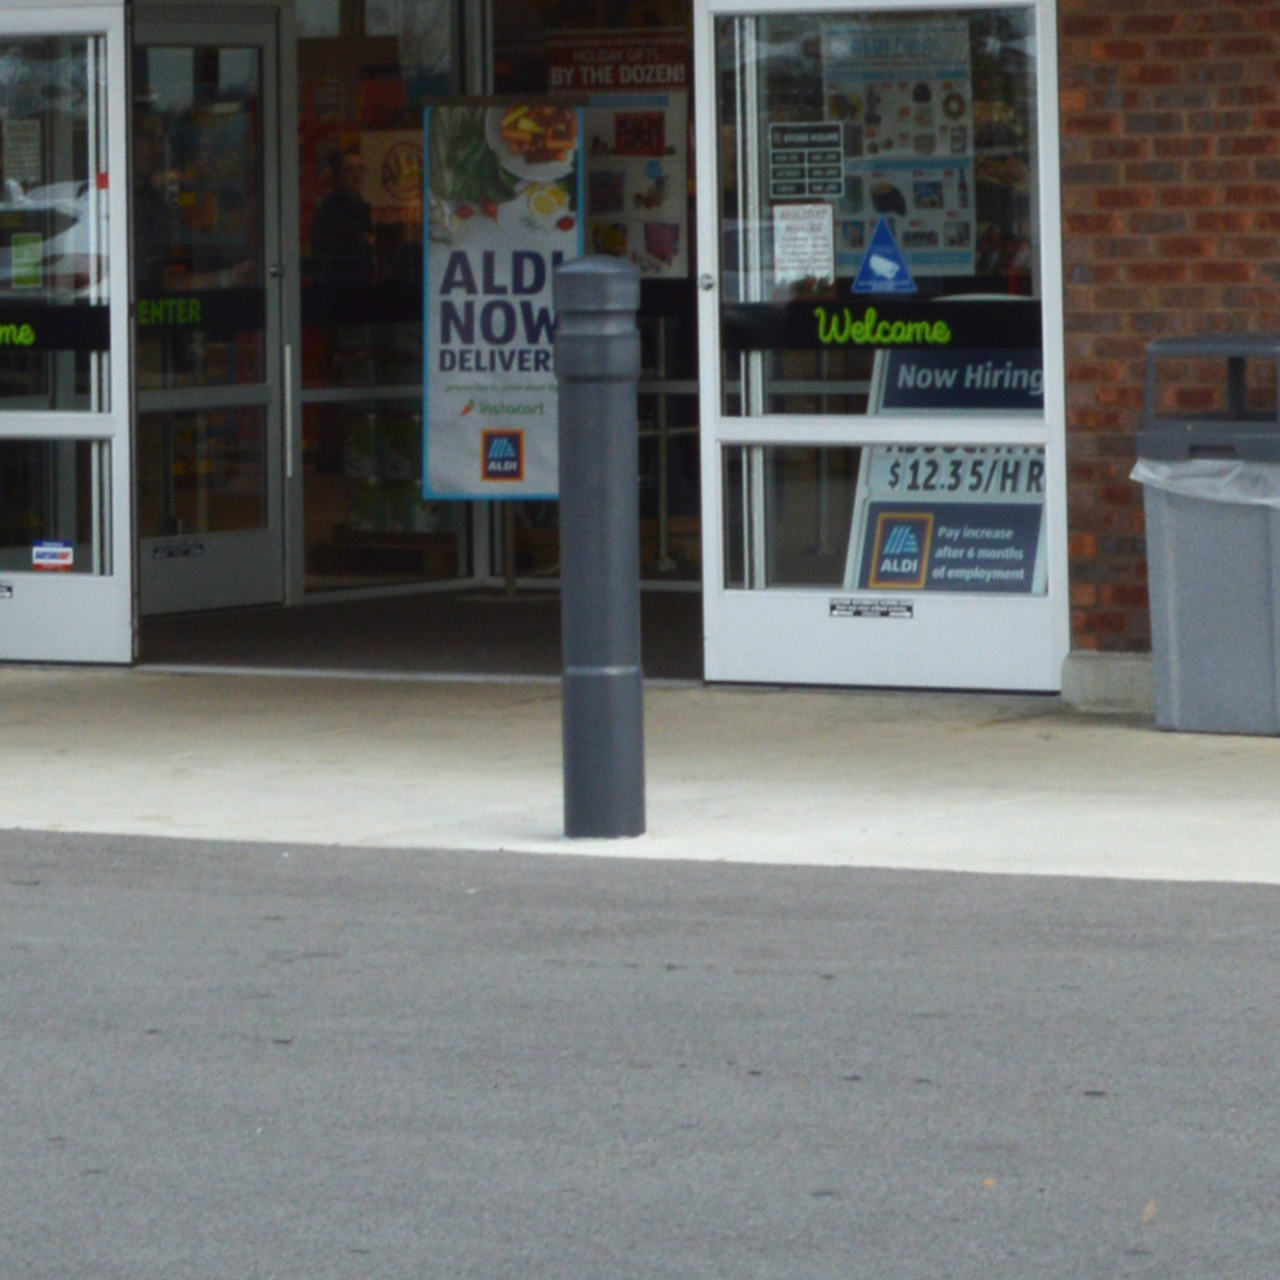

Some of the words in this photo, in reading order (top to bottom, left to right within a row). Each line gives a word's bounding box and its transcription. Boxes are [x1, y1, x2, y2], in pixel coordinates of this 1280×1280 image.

[550, 65, 575, 85] BY
[579, 64, 615, 84] THE
[618, 63, 686, 84] DOZEN!
[138, 298, 202, 325] ENTER
[440, 299, 558, 346] NOW
[814, 306, 952, 345] Welcome
[439, 349, 552, 372] DELIVER
[897, 363, 958, 389] Now
[964, 360, 1044, 396] Hiring
[487, 460, 518, 471] ALDI
[937, 525, 960, 541] Pay
[963, 525, 1014, 539] increase
[934, 547, 964, 560] after
[966, 547, 975, 559] 6
[977, 547, 1024, 560] months
[880, 558, 919, 573] ALDI
[932, 566, 945, 579] of
[946, 566, 1025, 583] employment
